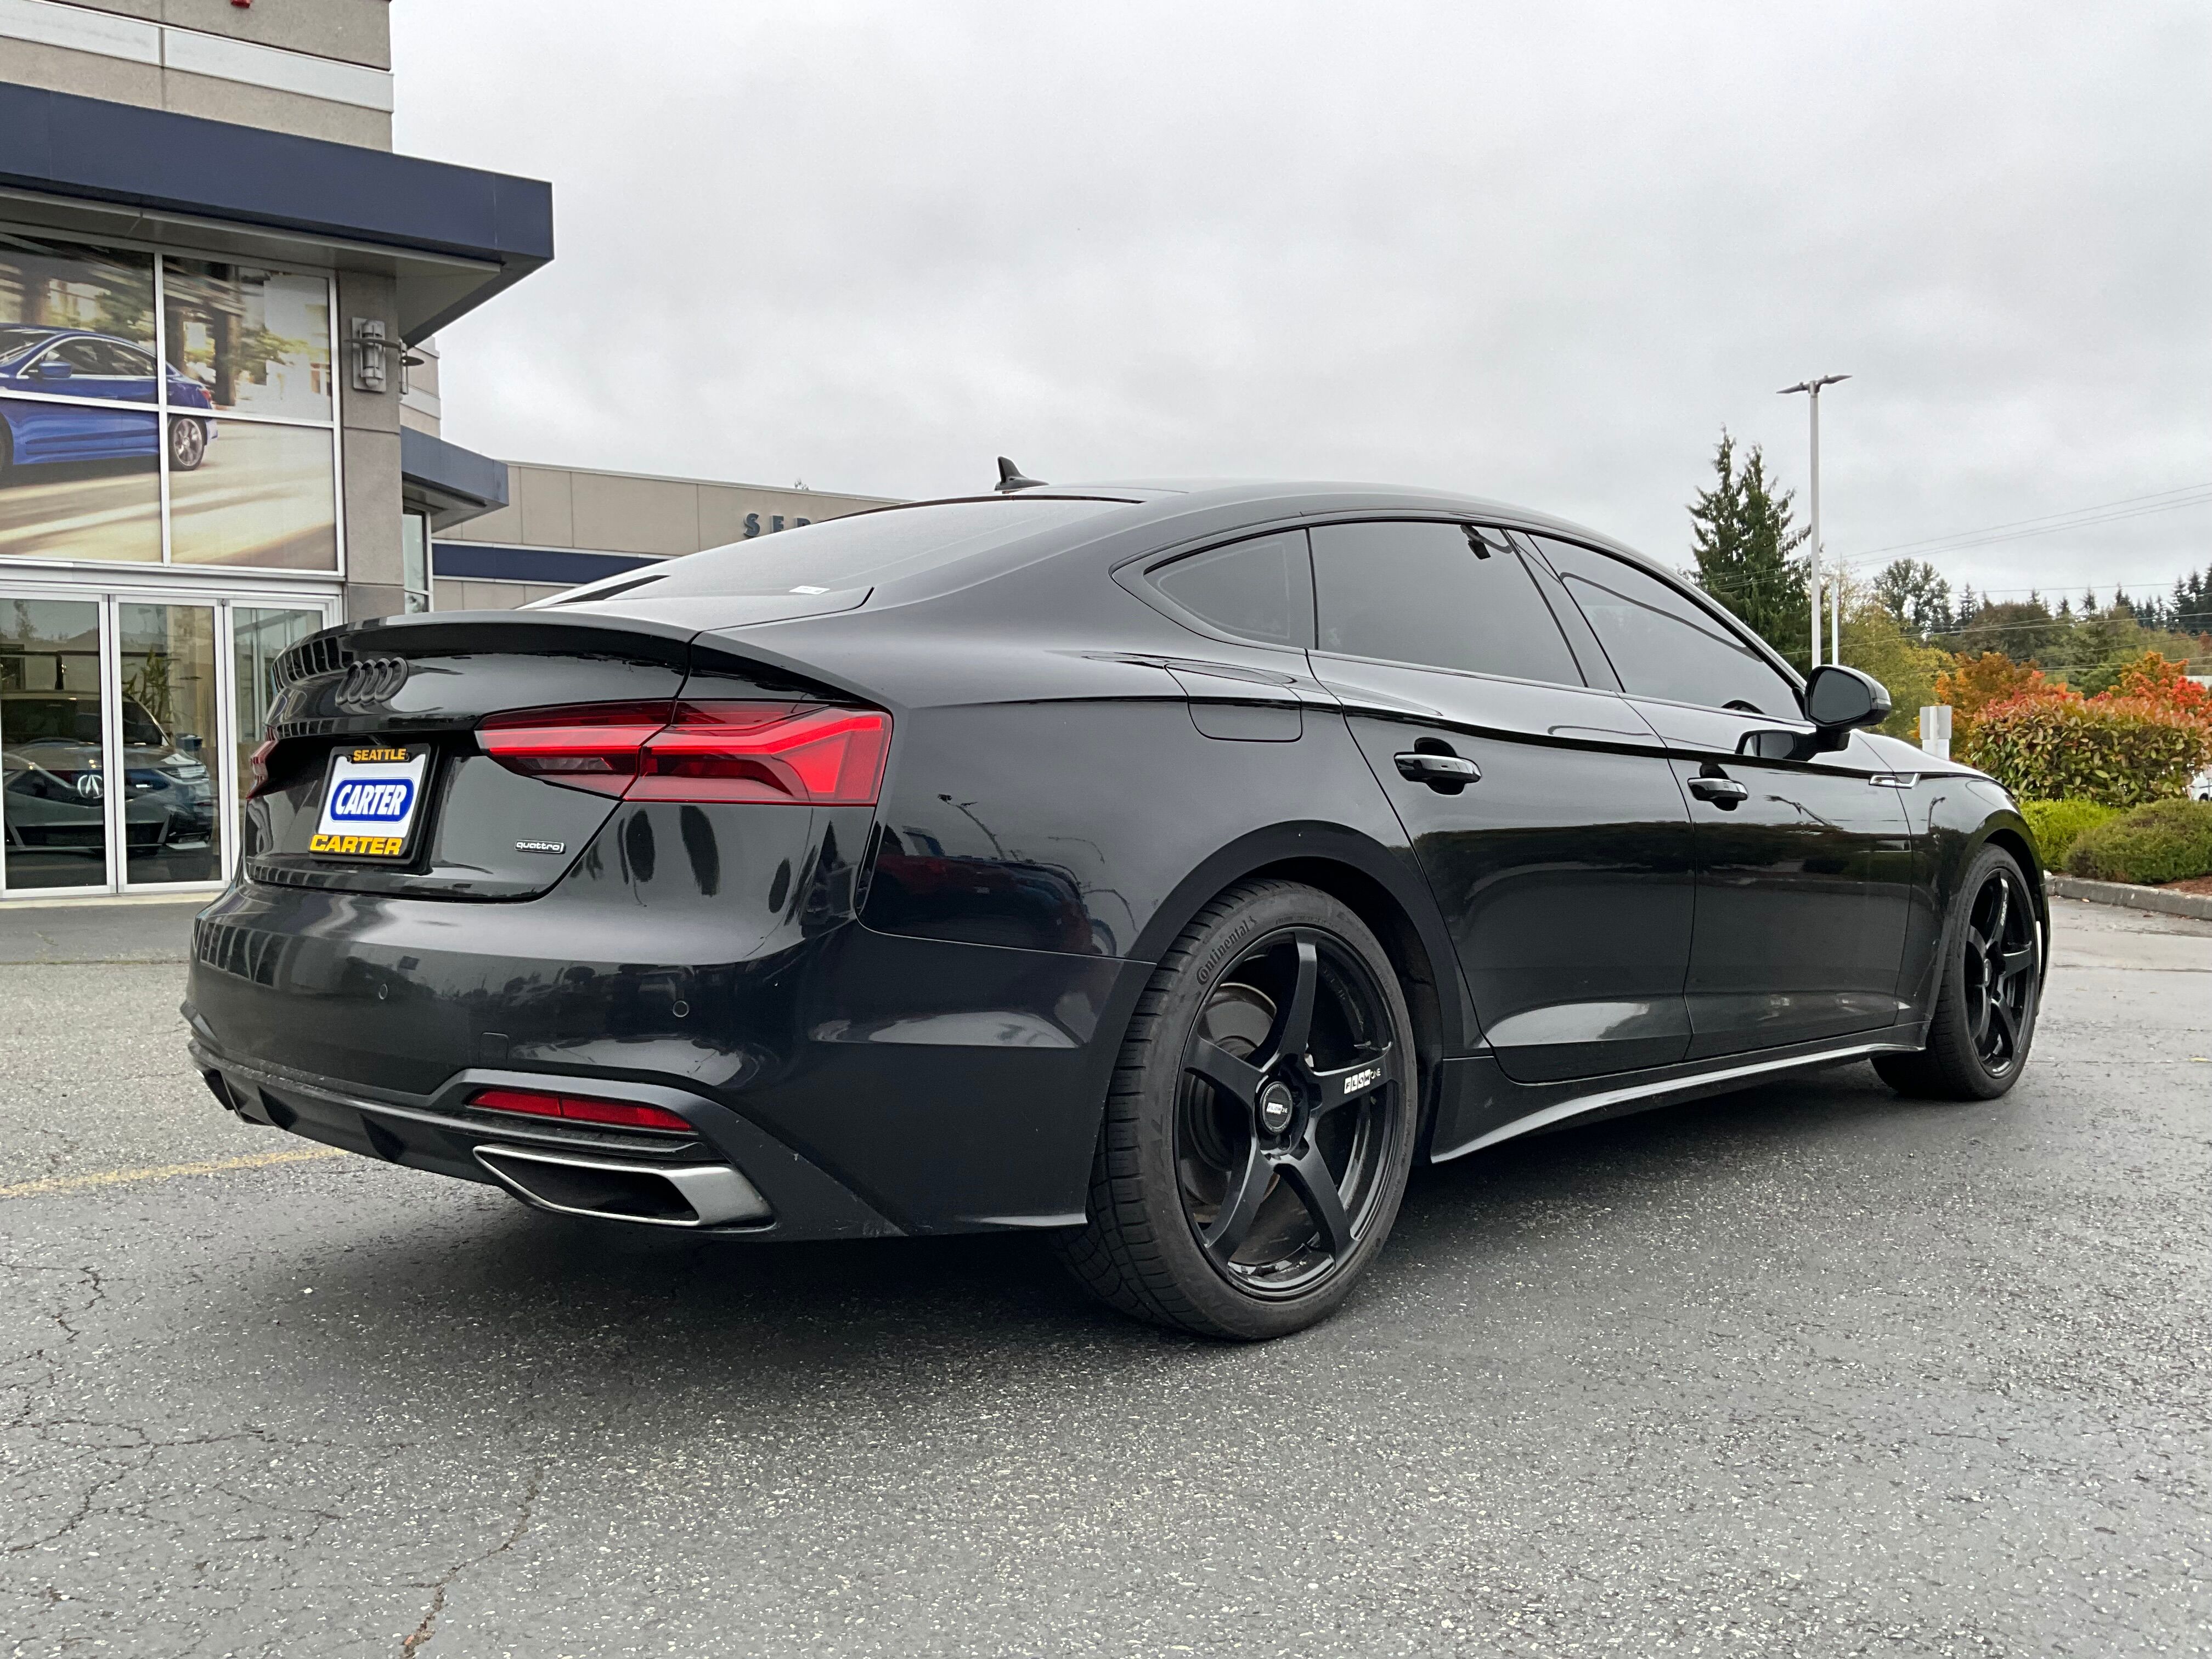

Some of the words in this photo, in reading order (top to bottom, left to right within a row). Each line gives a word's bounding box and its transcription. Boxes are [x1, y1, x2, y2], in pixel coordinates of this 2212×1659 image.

[353, 748, 407, 761] SEATTLE
[335, 784, 407, 815] CARTER
[309, 834, 403, 855] CARTER
[516, 842, 560, 850] quattro
[1197, 919, 1252, 985] Continental
